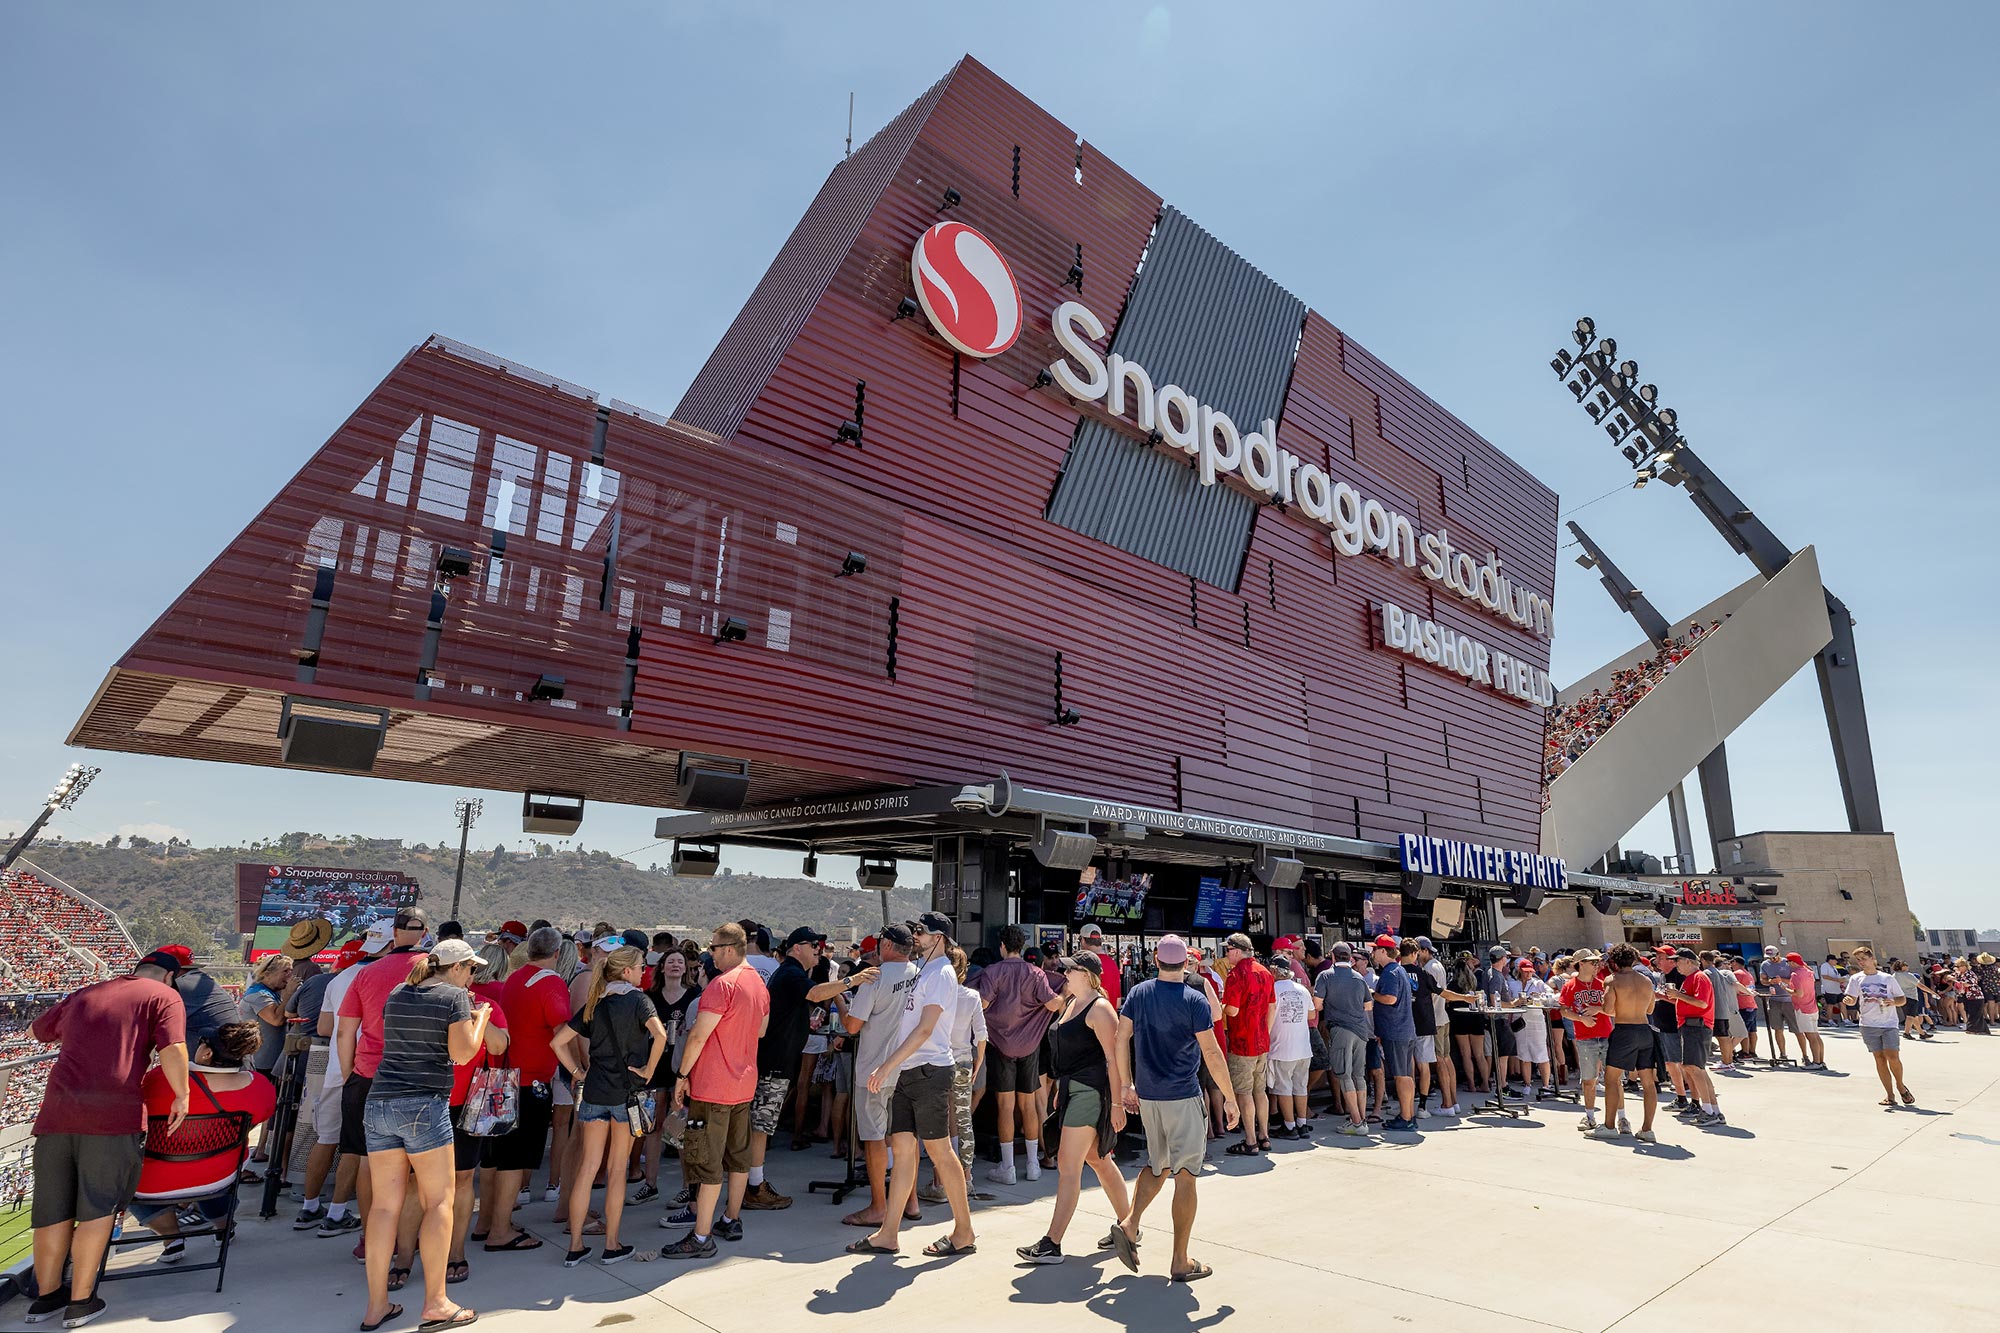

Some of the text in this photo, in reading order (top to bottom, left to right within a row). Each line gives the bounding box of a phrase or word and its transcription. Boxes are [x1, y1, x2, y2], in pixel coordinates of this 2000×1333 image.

[1049, 301, 1556, 640] Snapdragon stadium
[1382, 602, 1555, 708] BASHOR FIELD
[710, 795, 909, 825] AWARD-WINNING CANNED COCKTAILS AND SPIRITS
[1092, 804, 1325, 849] AWARD-WINNING CANNED COCKTAILS AND SPIRITS
[284, 867, 398, 882] Snapdragon stadium
[1404, 833, 1569, 890] CUTWATER SPIRITS
[892, 980, 905, 994] JUST
